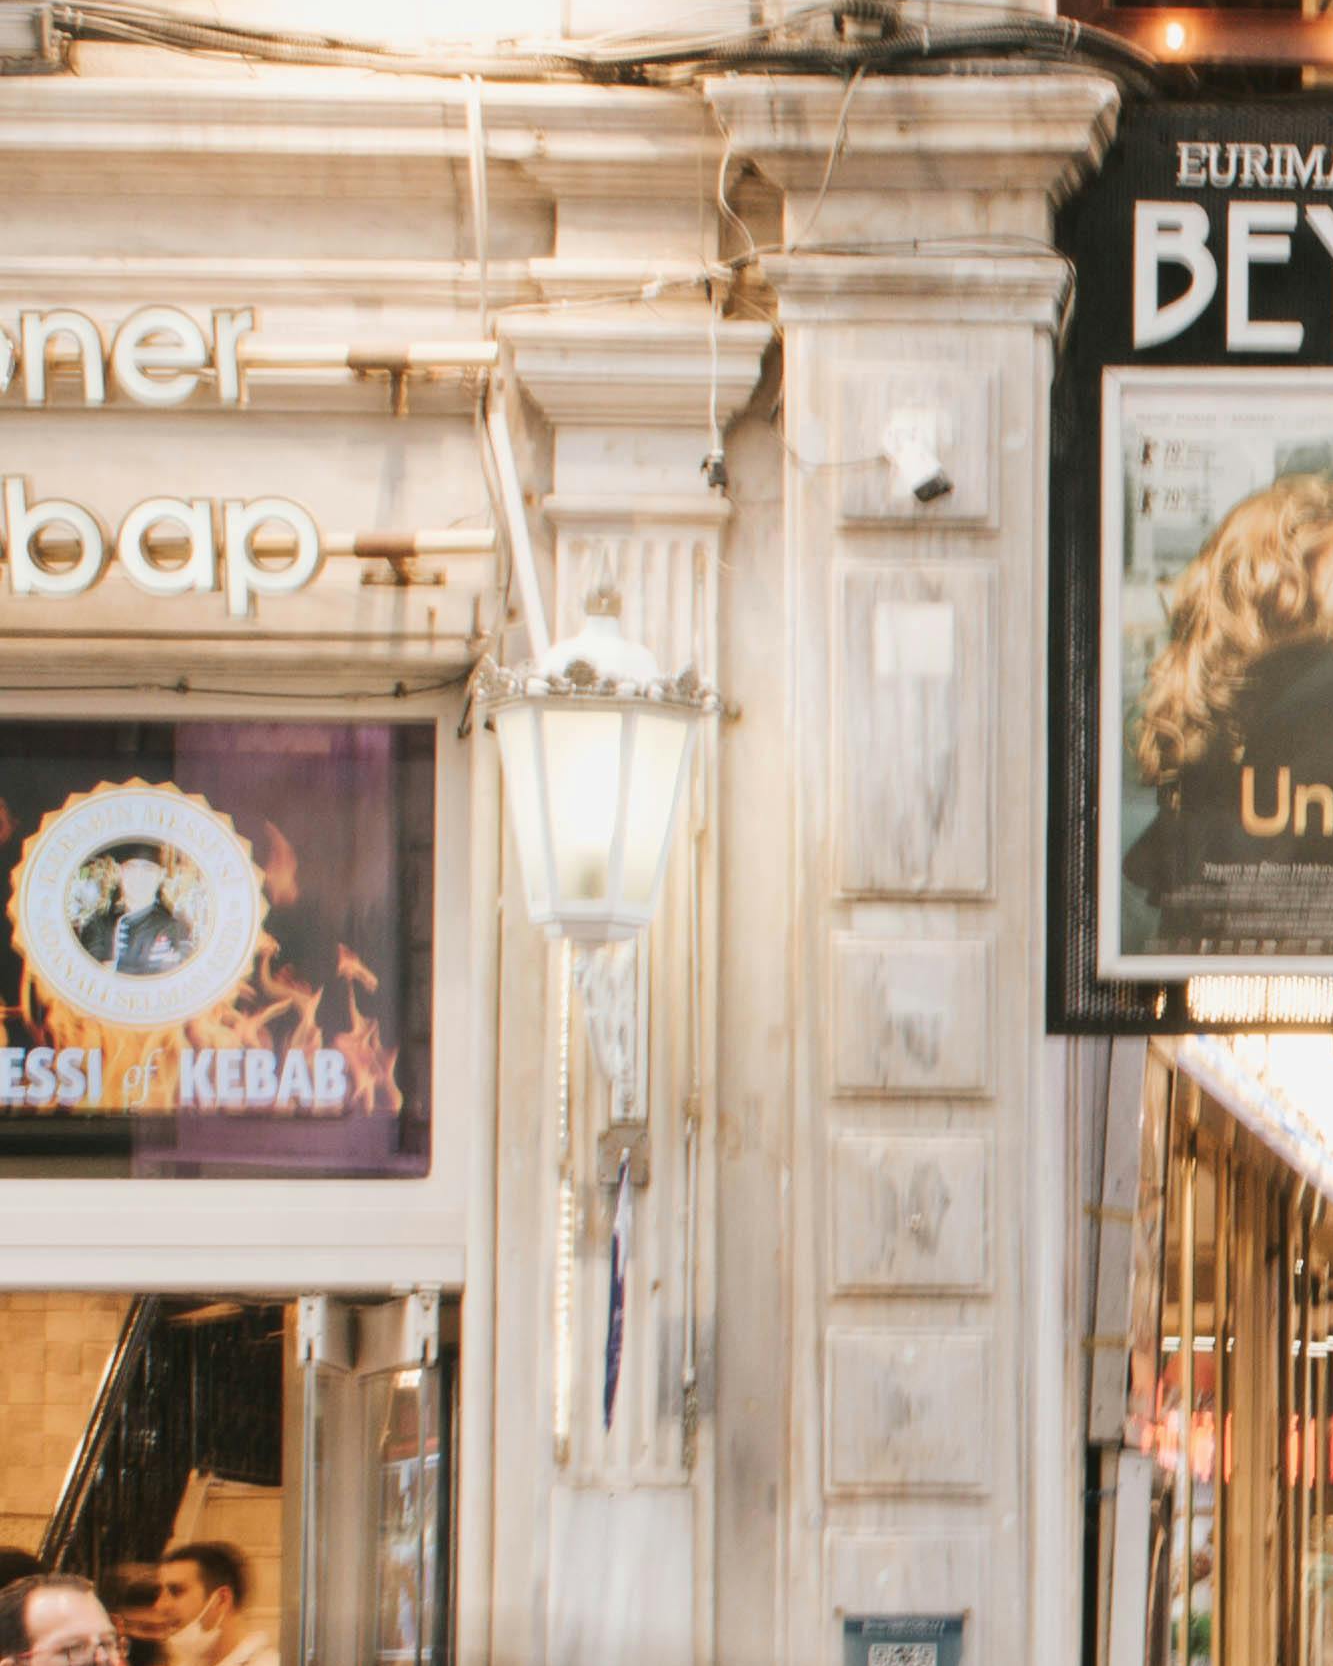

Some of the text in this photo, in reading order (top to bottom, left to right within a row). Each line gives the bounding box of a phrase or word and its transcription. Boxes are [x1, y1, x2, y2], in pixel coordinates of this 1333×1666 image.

[0, 305, 258, 406] ner
[4, 474, 321, 617] bap
[122, 1047, 164, 1108] of
[180, 1047, 348, 1107] KEBAB
